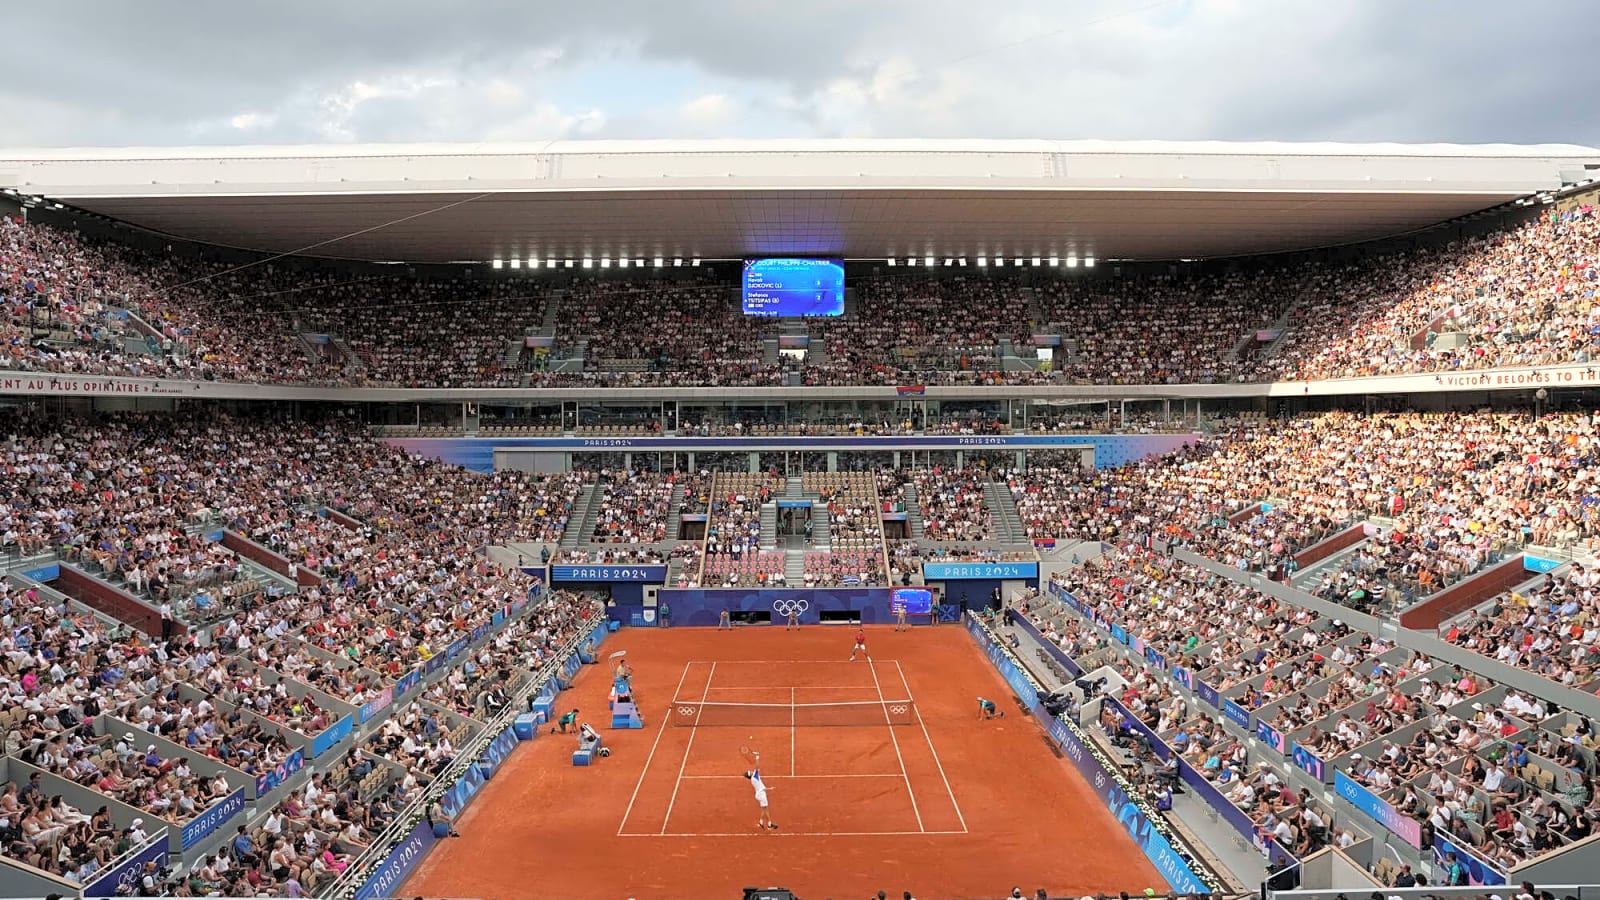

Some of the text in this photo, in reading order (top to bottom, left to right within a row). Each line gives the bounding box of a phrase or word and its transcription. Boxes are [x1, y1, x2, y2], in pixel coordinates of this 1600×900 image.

[0, 379, 139, 392] NT AU PLUS OPINIÂTRE
[1447, 370, 1600, 386] VICTORY BELONGS TO TH
[572, 569, 647, 578] PARIS 2024
[944, 567, 1019, 576] PARIS 2024
[1056, 726, 1082, 762] PARIS 2024
[188, 796, 241, 841] PARIS 2024
[1372, 803, 1393, 823] PARIS
[373, 837, 423, 898] PARIS 2024
[1158, 848, 1183, 884] PARIS
